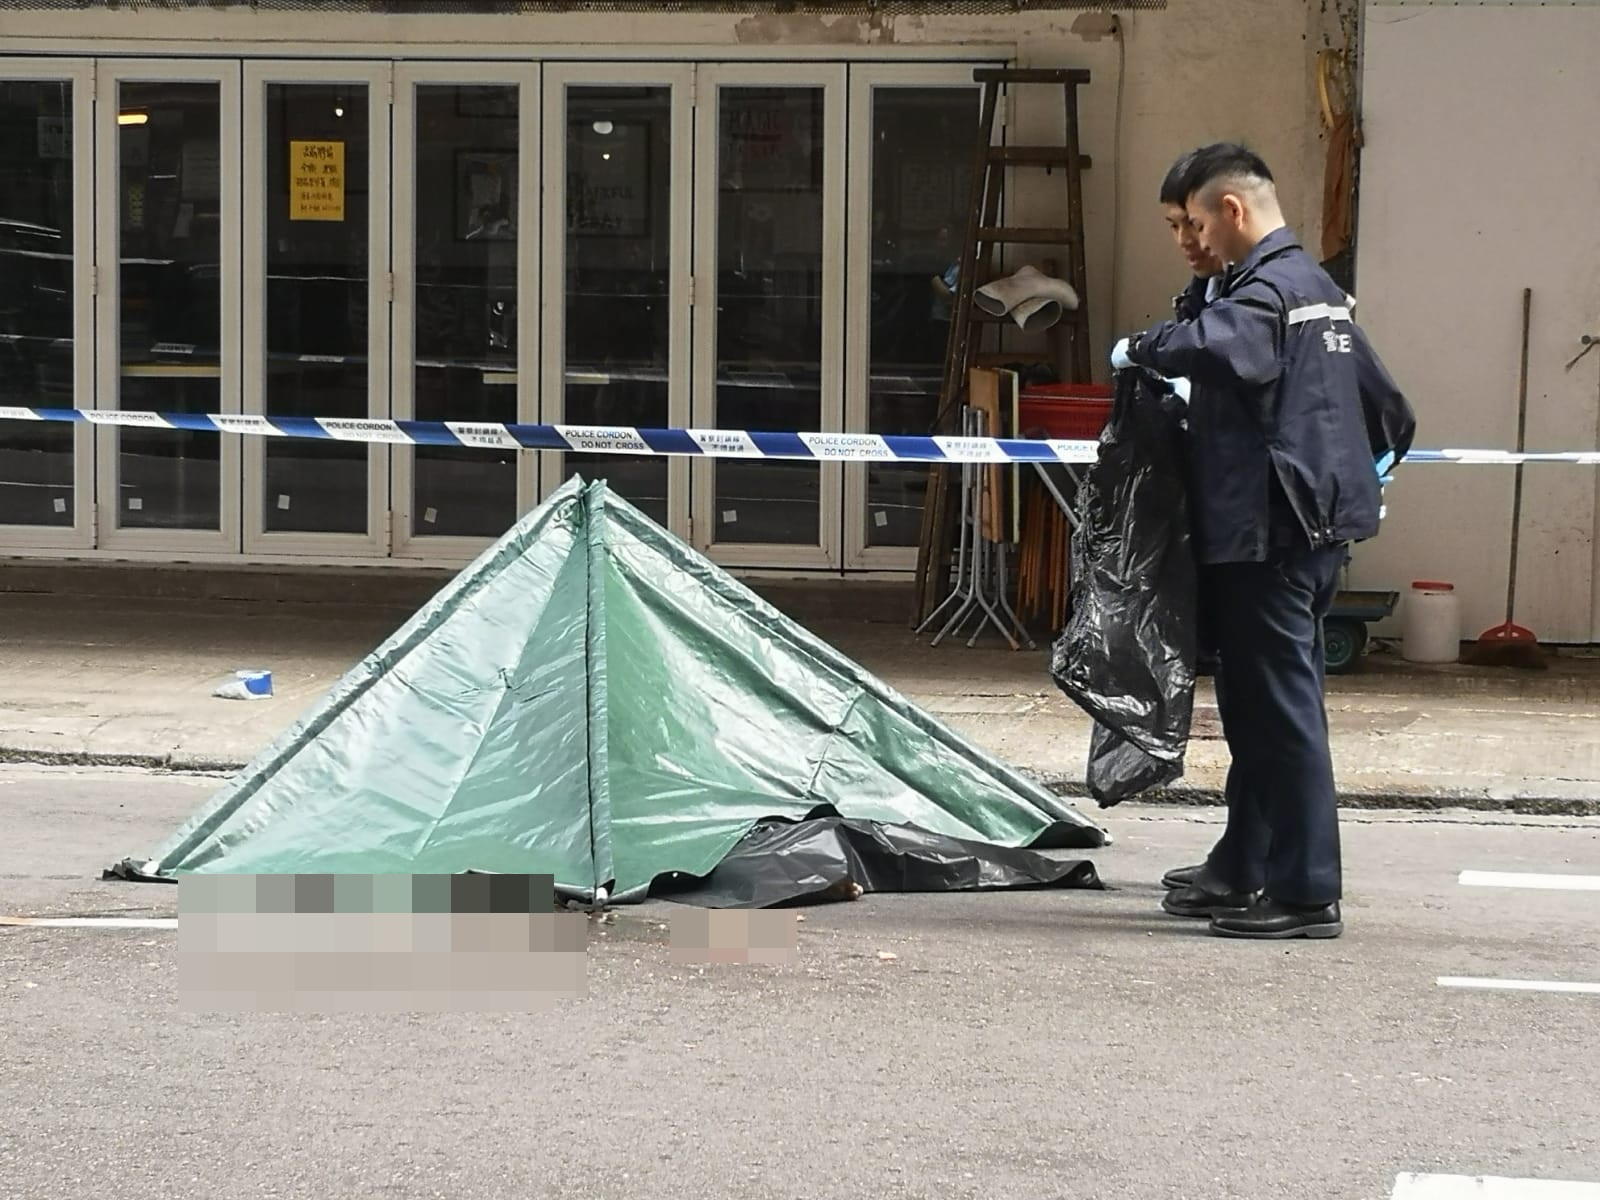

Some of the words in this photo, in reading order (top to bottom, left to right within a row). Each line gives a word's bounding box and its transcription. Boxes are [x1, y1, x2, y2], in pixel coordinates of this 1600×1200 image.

[566, 430, 595, 438] POLICE
[809, 436, 839, 445] POLICE
[595, 441, 612, 449] NOT
[615, 442, 645, 450] CROSS
[824, 448, 837, 456] DO
